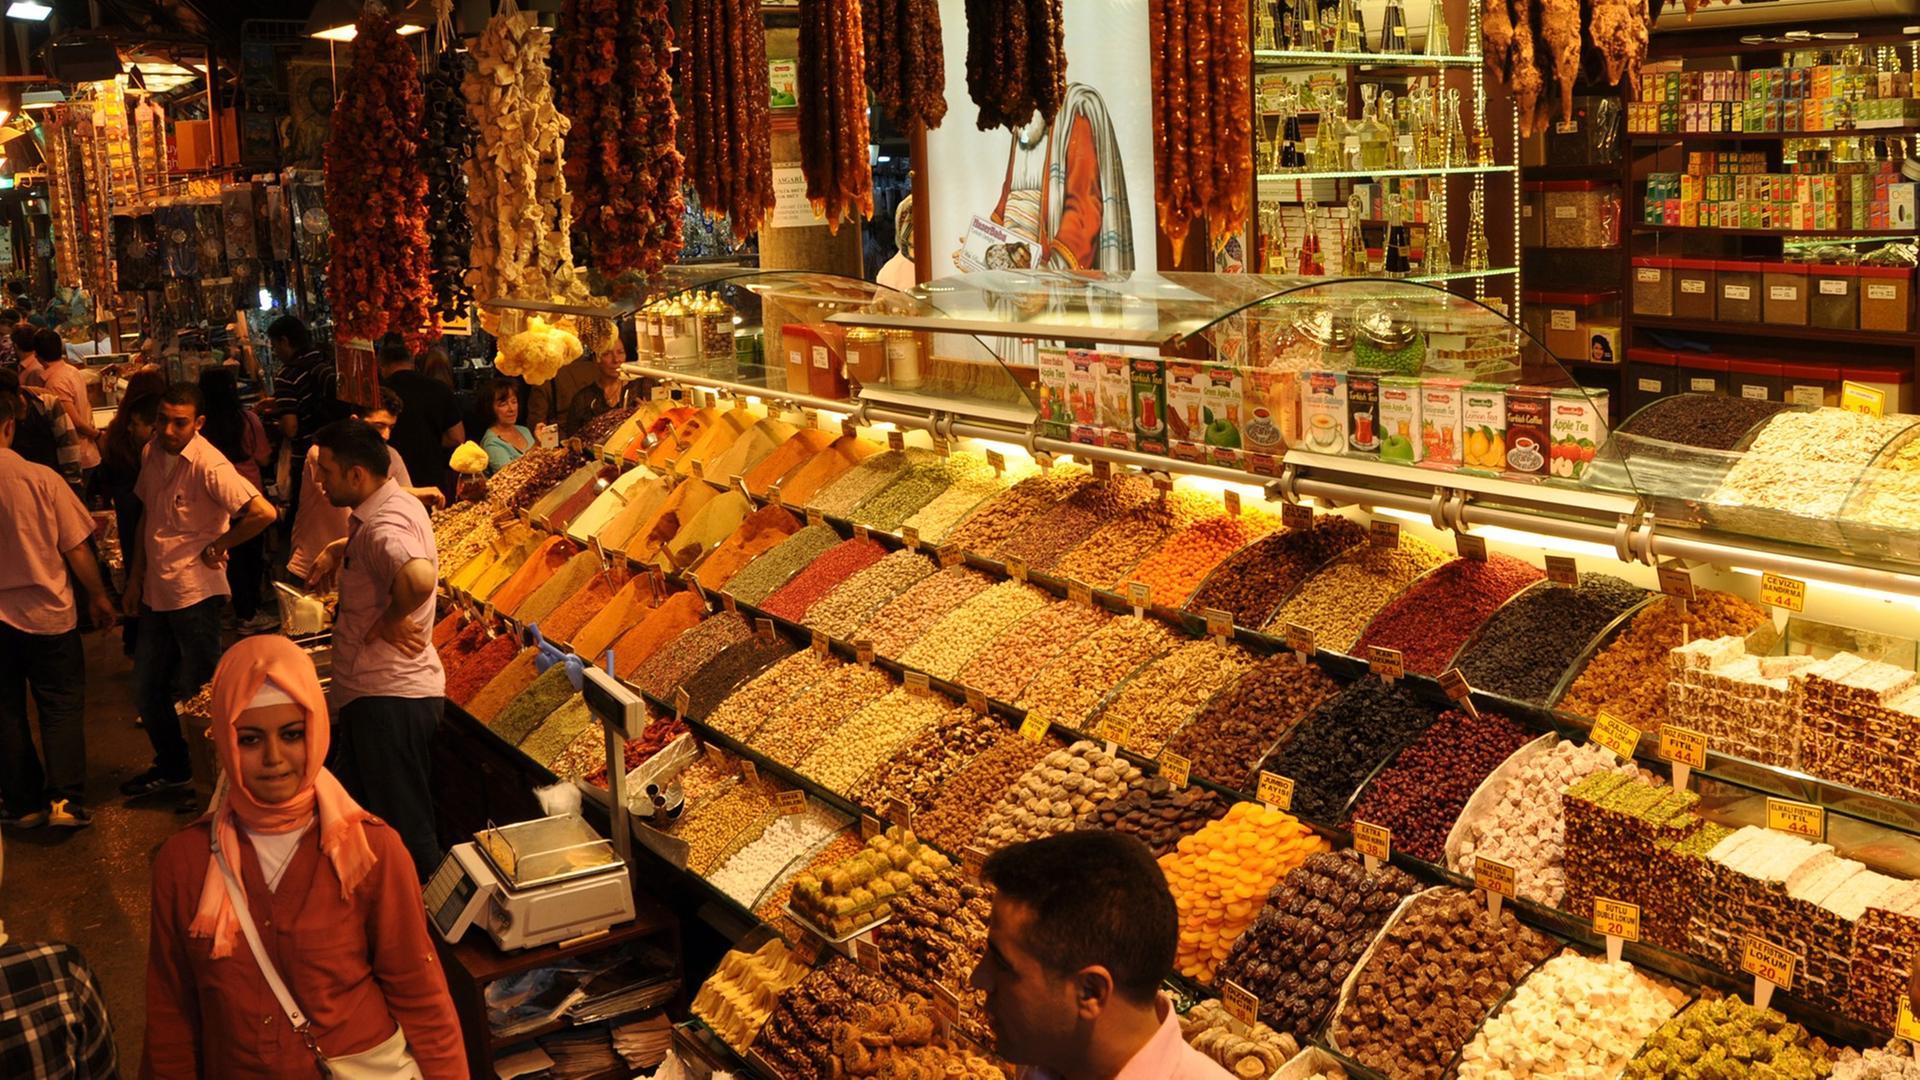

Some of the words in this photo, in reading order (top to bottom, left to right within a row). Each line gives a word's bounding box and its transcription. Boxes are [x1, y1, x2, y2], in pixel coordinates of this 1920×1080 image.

[1464, 409, 1485, 420] Lemon
[1486, 410, 1499, 421] Tea
[1552, 418, 1576, 431] Apple
[1577, 419, 1591, 431] Tea
[1767, 576, 1800, 589] CEVIZLI
[1764, 584, 1801, 597] BANDIRMA
[1775, 597, 1791, 606] 44
[1606, 736, 1620, 750] 20
[1675, 750, 1691, 762] 44
[1263, 776, 1289, 789] JUMBO
[1261, 783, 1289, 797] KAYISI
[1269, 793, 1282, 804] 22
[1362, 825, 1381, 837] EXTRA
[1789, 822, 1808, 833] 44
[1366, 843, 1378, 856] 38
[1487, 879, 1501, 891] 20
[1608, 922, 1623, 935] 20
[1750, 948, 1787, 972] LOKUM
[1759, 964, 1776, 980] 20
